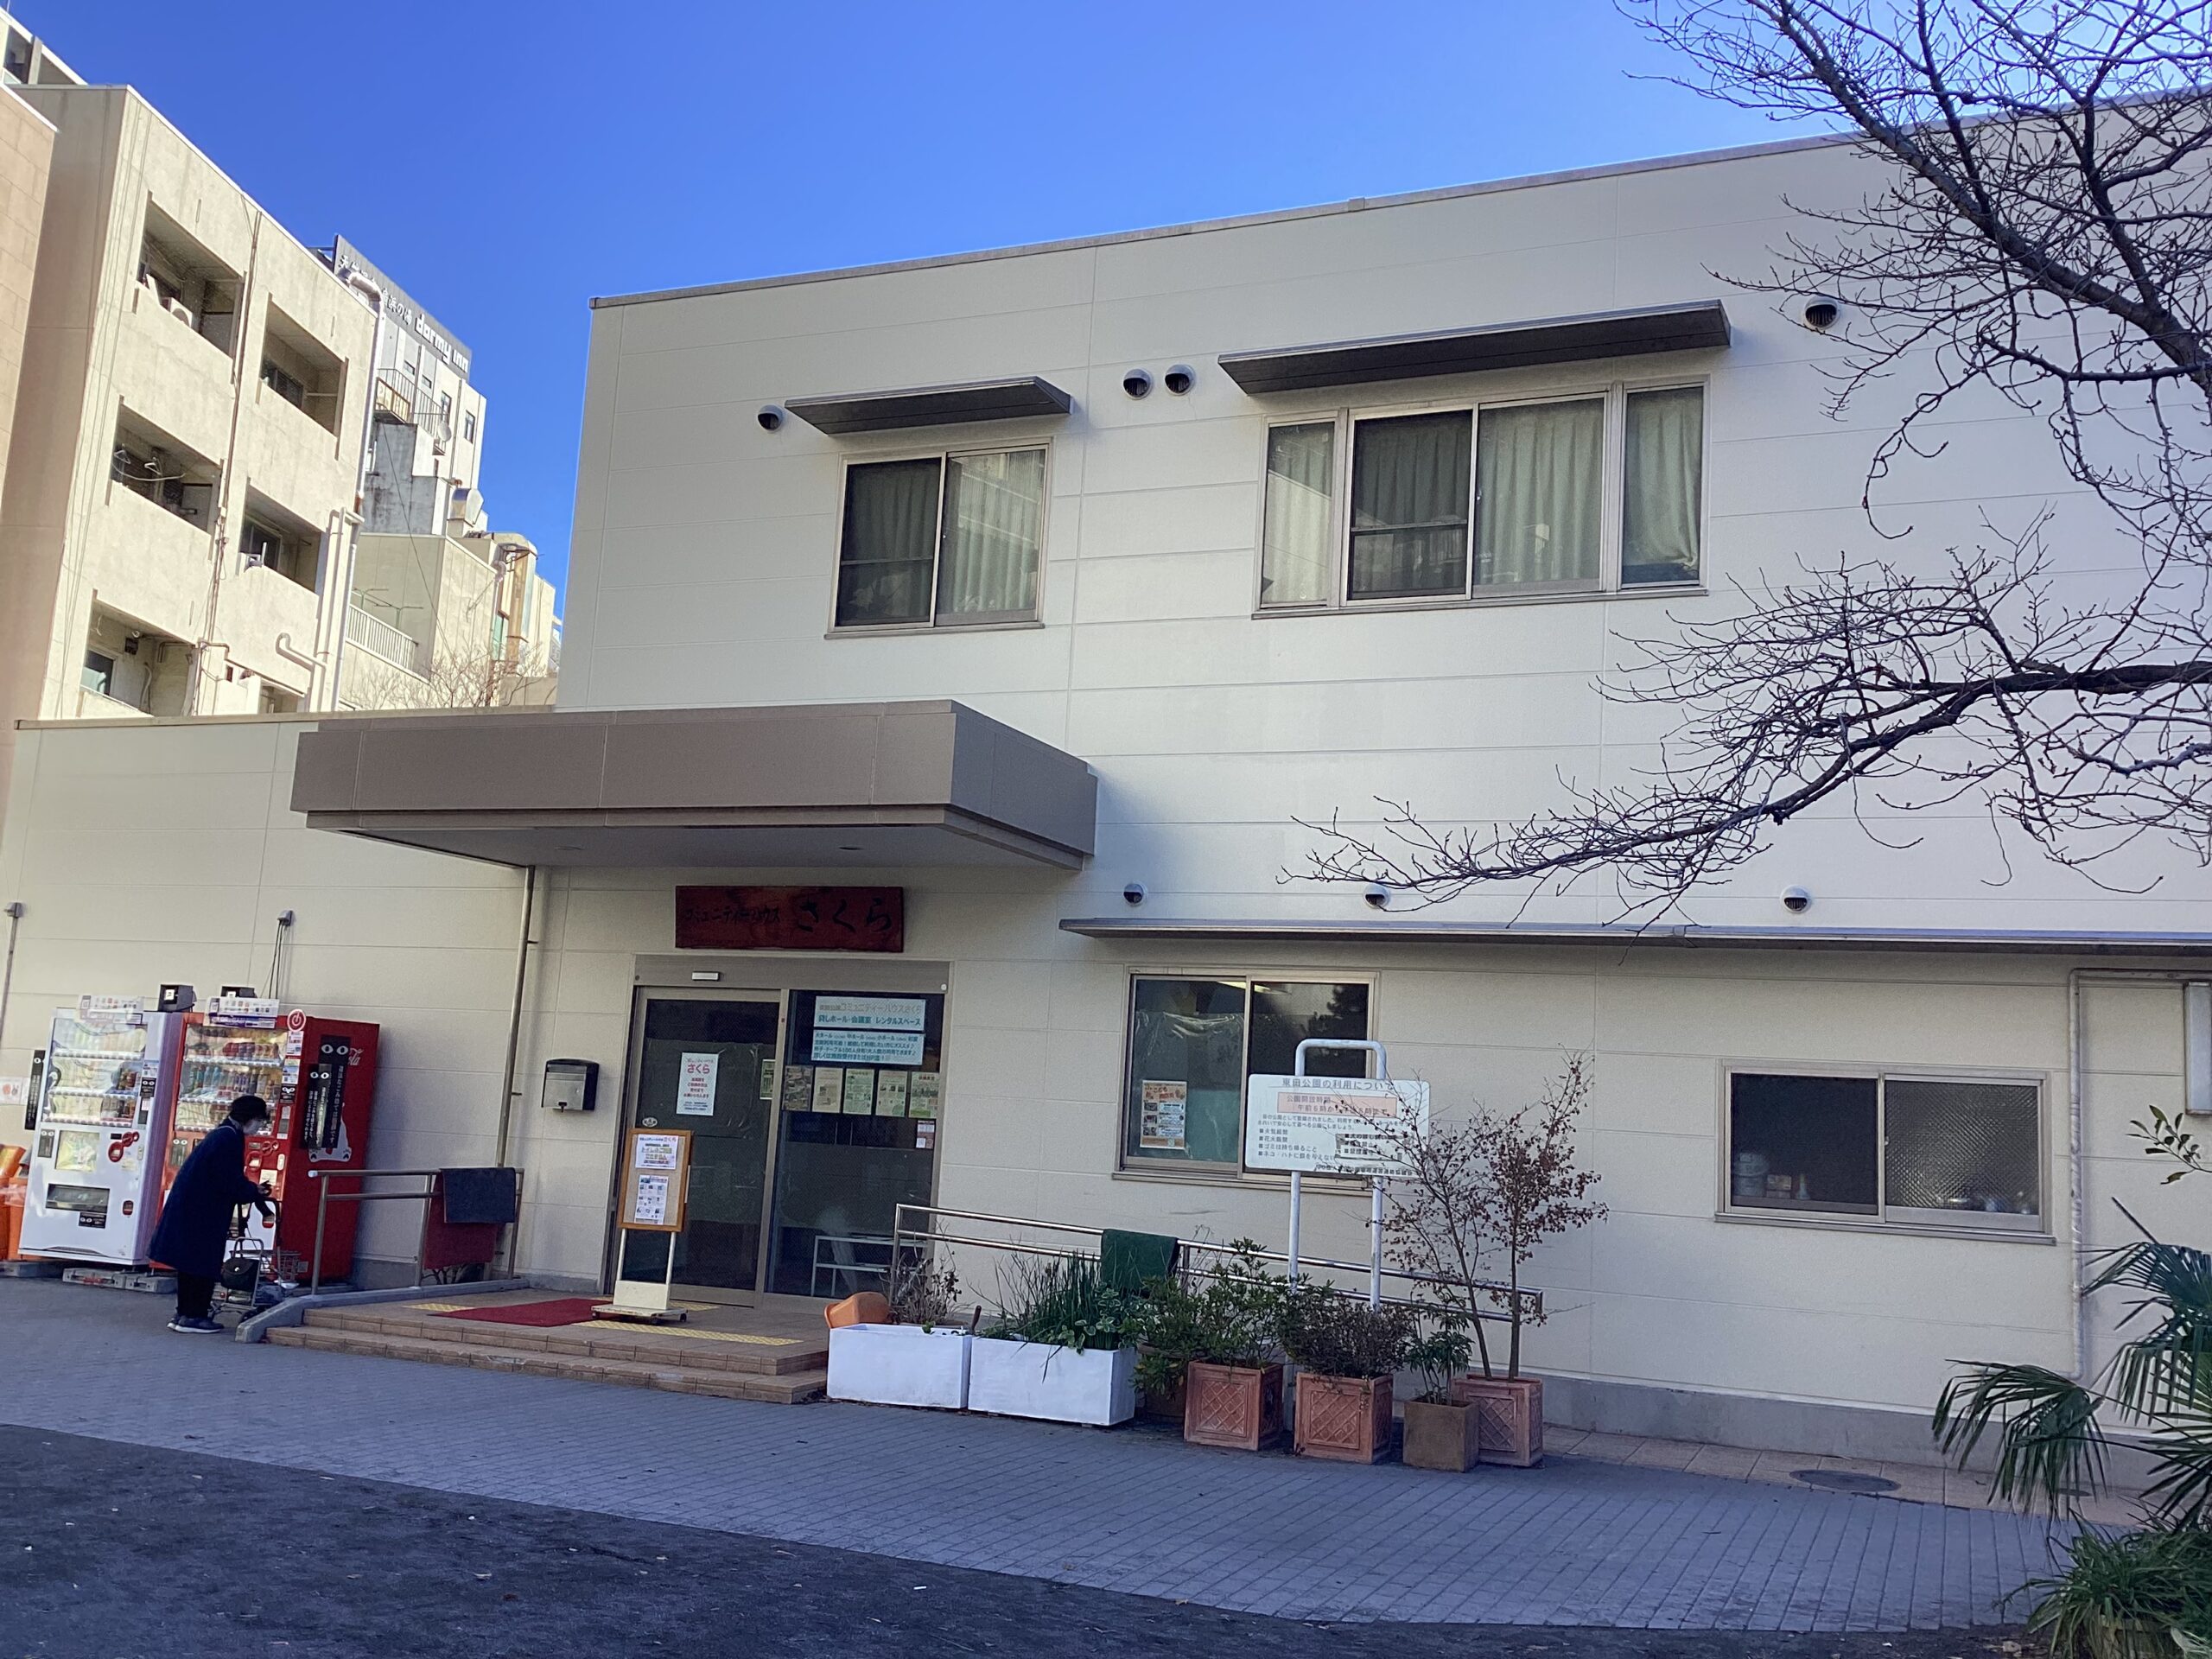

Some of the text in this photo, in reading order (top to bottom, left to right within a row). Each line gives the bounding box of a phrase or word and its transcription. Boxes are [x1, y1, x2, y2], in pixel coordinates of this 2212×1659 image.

[416, 314, 469, 372] dormy inn
[797, 897, 893, 933] さくら
[687, 1063, 710, 1074] さくら
[1281, 1077, 1394, 1090] 東田公園の利用について
